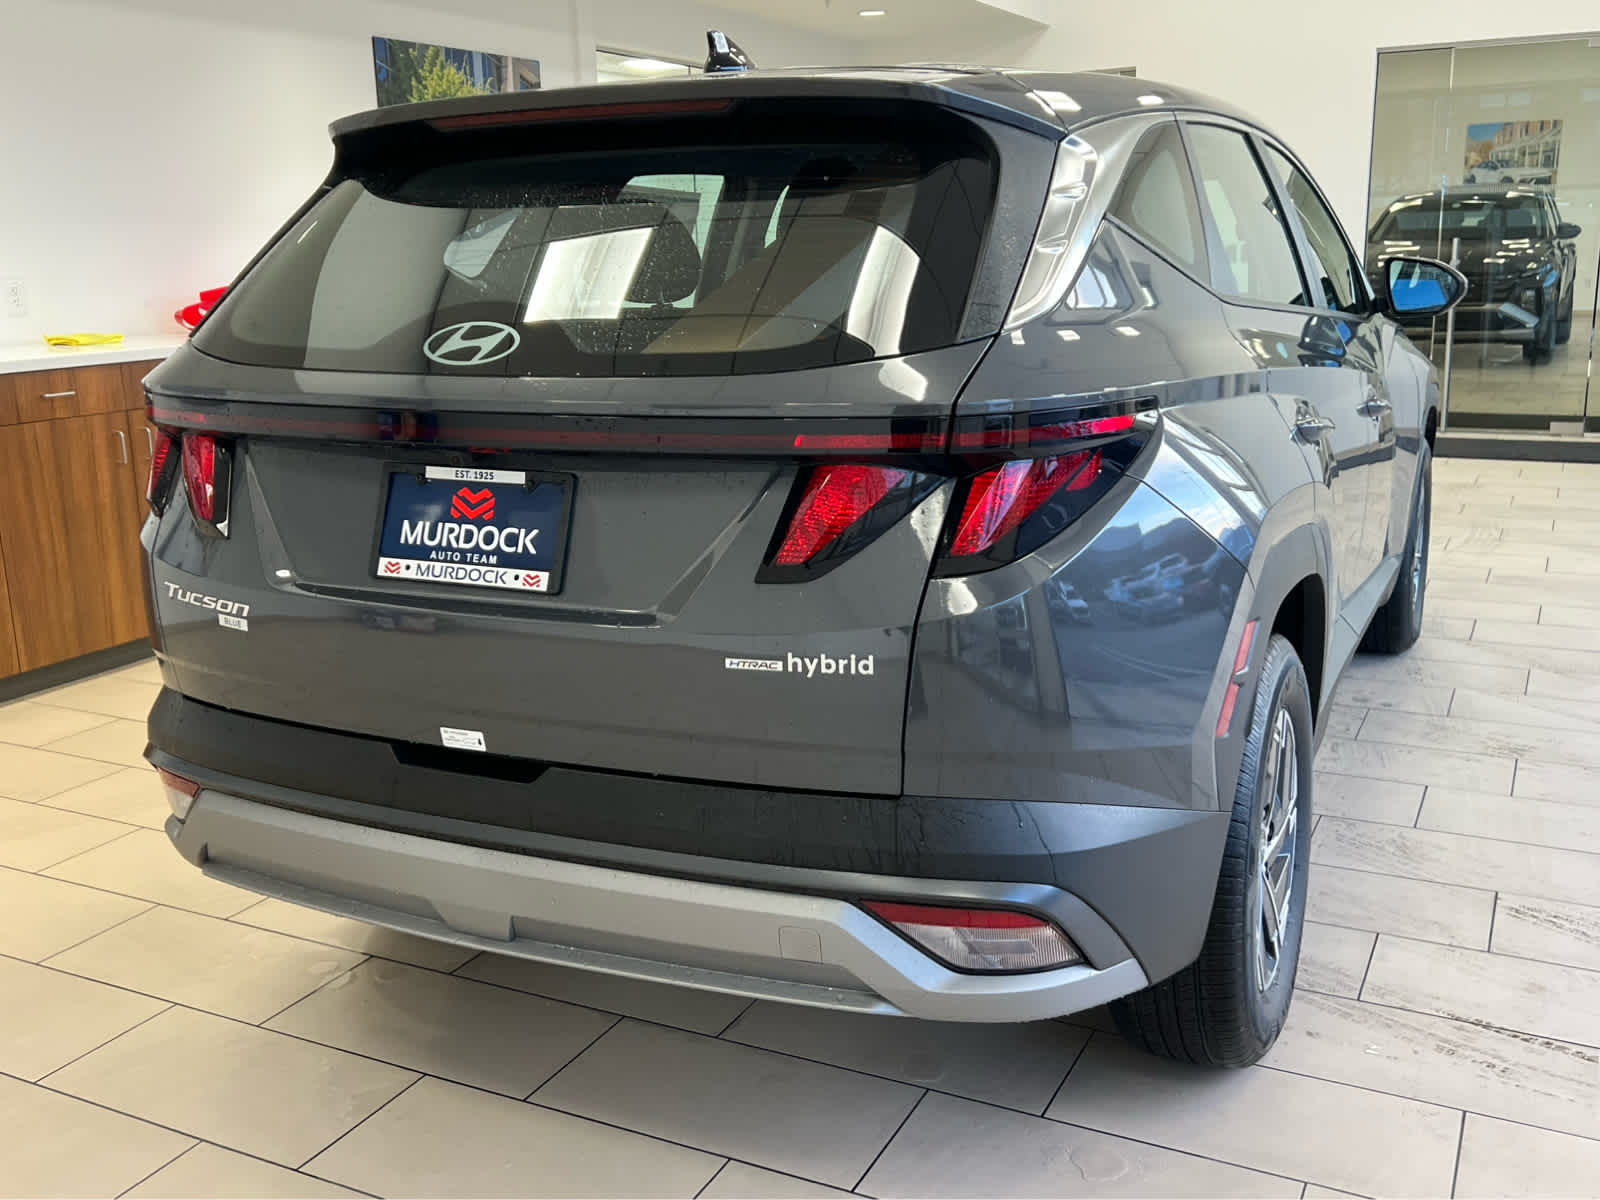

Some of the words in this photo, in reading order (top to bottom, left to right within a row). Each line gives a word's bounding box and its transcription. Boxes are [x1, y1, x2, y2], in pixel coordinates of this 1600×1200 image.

[455, 469, 471, 479] EST.
[474, 471, 494, 480] 1925
[400, 520, 539, 554] MURDOCK
[430, 550, 460, 561] AUTO
[466, 553, 497, 564] TEAM
[415, 563, 508, 584] MURDOCK
[728, 659, 779, 670] HTRAC
[787, 652, 874, 678] hybrid
